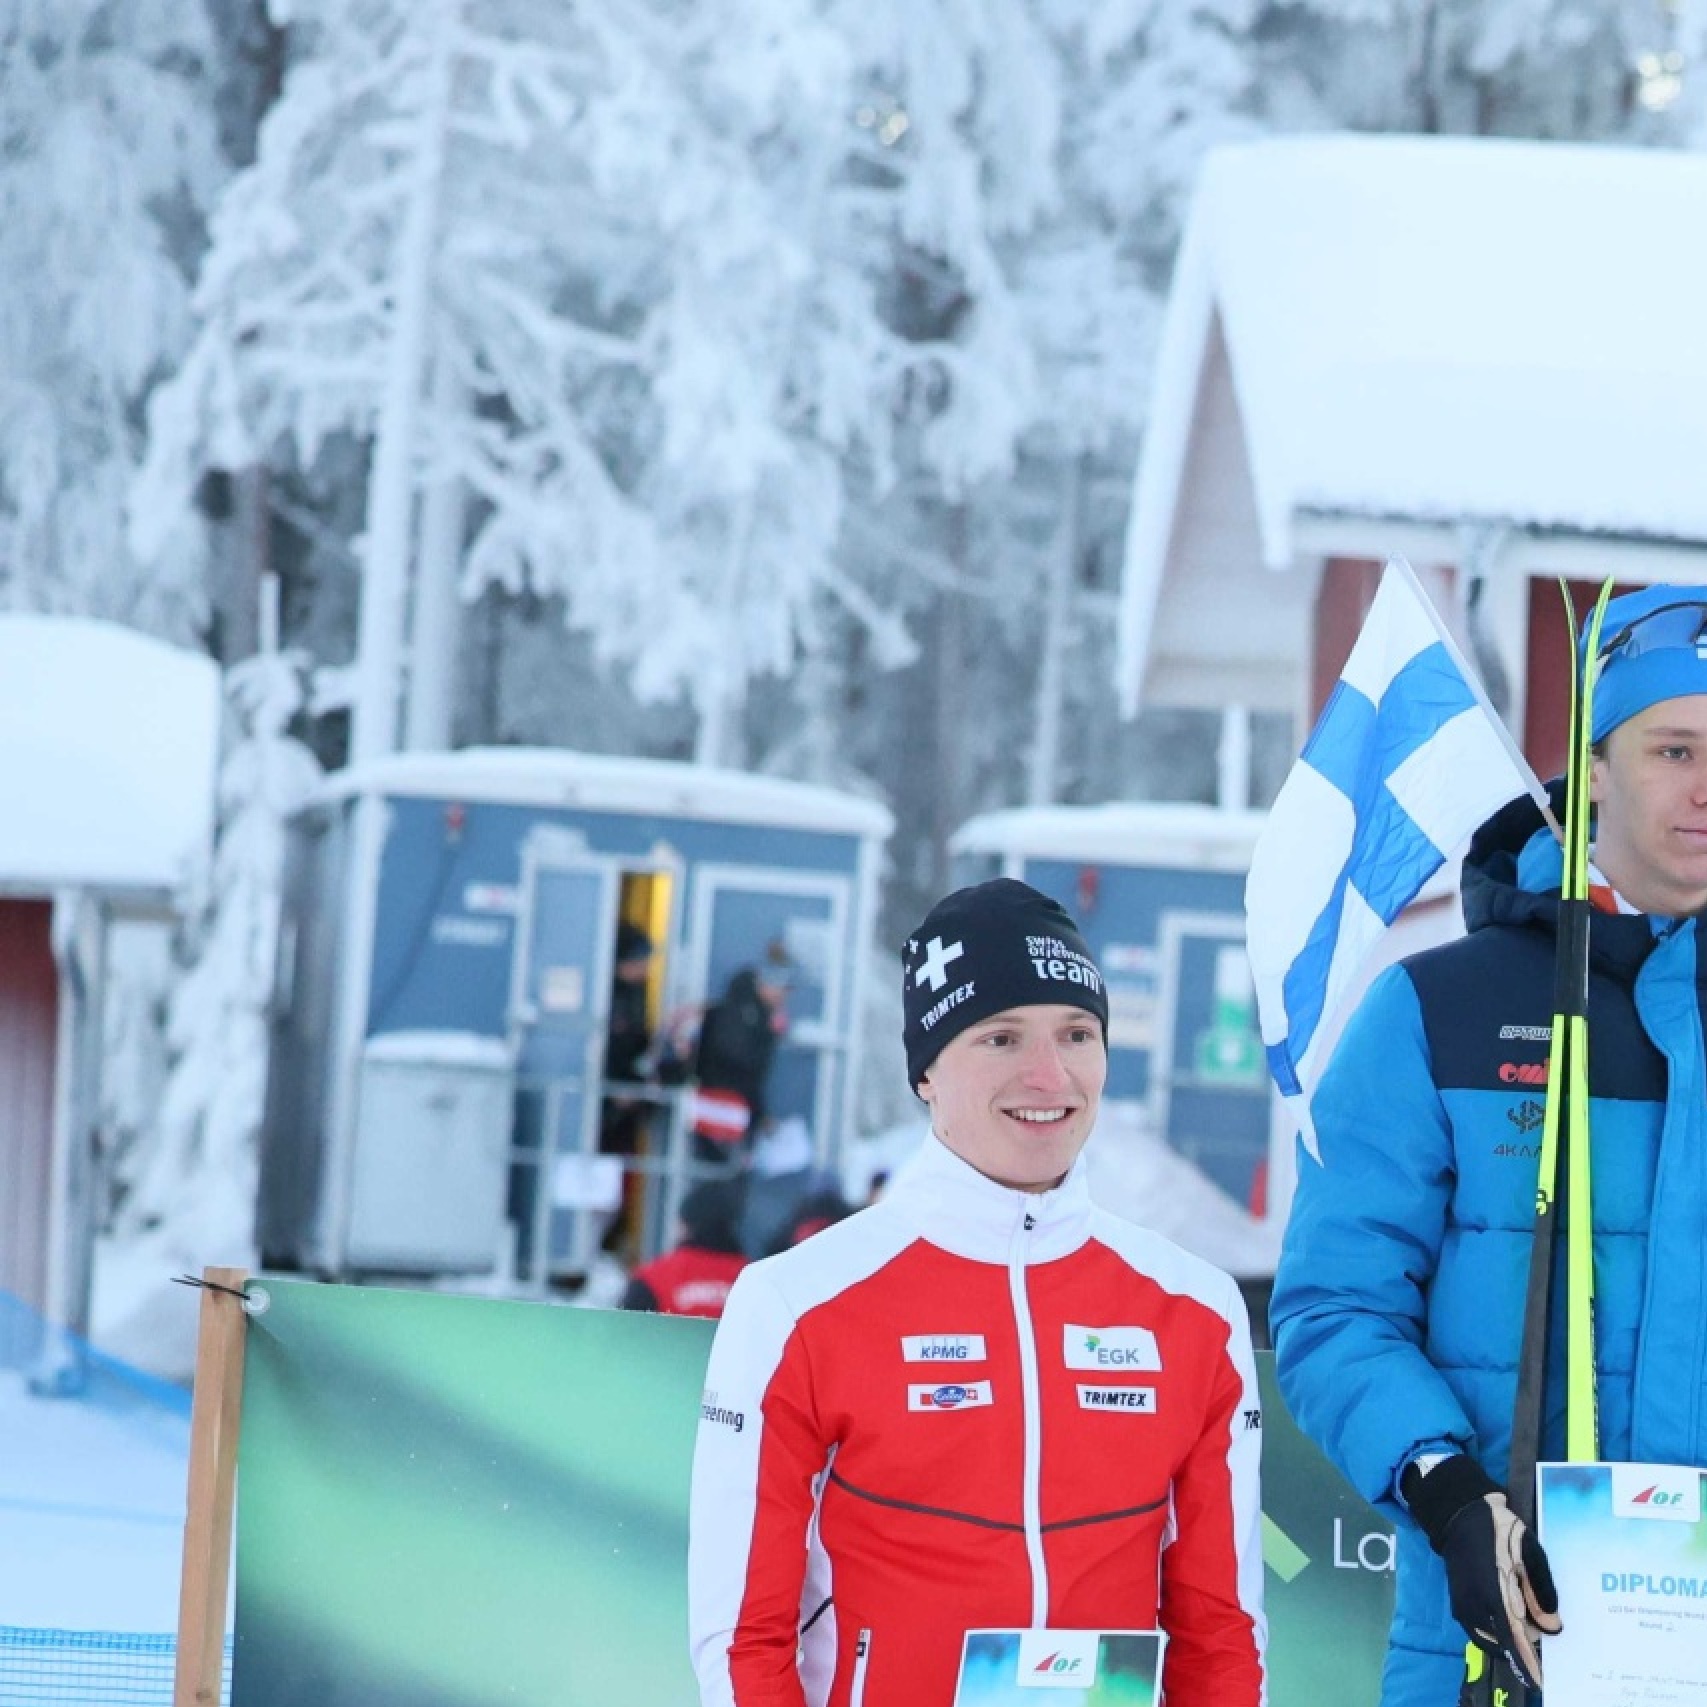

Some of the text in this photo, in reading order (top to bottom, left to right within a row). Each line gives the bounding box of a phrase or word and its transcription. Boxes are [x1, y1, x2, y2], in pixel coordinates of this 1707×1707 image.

[1031, 959, 1101, 995] team
[920, 980, 977, 1032] TRIMTEX
[920, 1344, 969, 1359] KPMG
[1098, 1348, 1140, 1364] EGK
[1084, 1390, 1147, 1407] TRIMTEX
[1333, 1517, 1397, 1571] La
